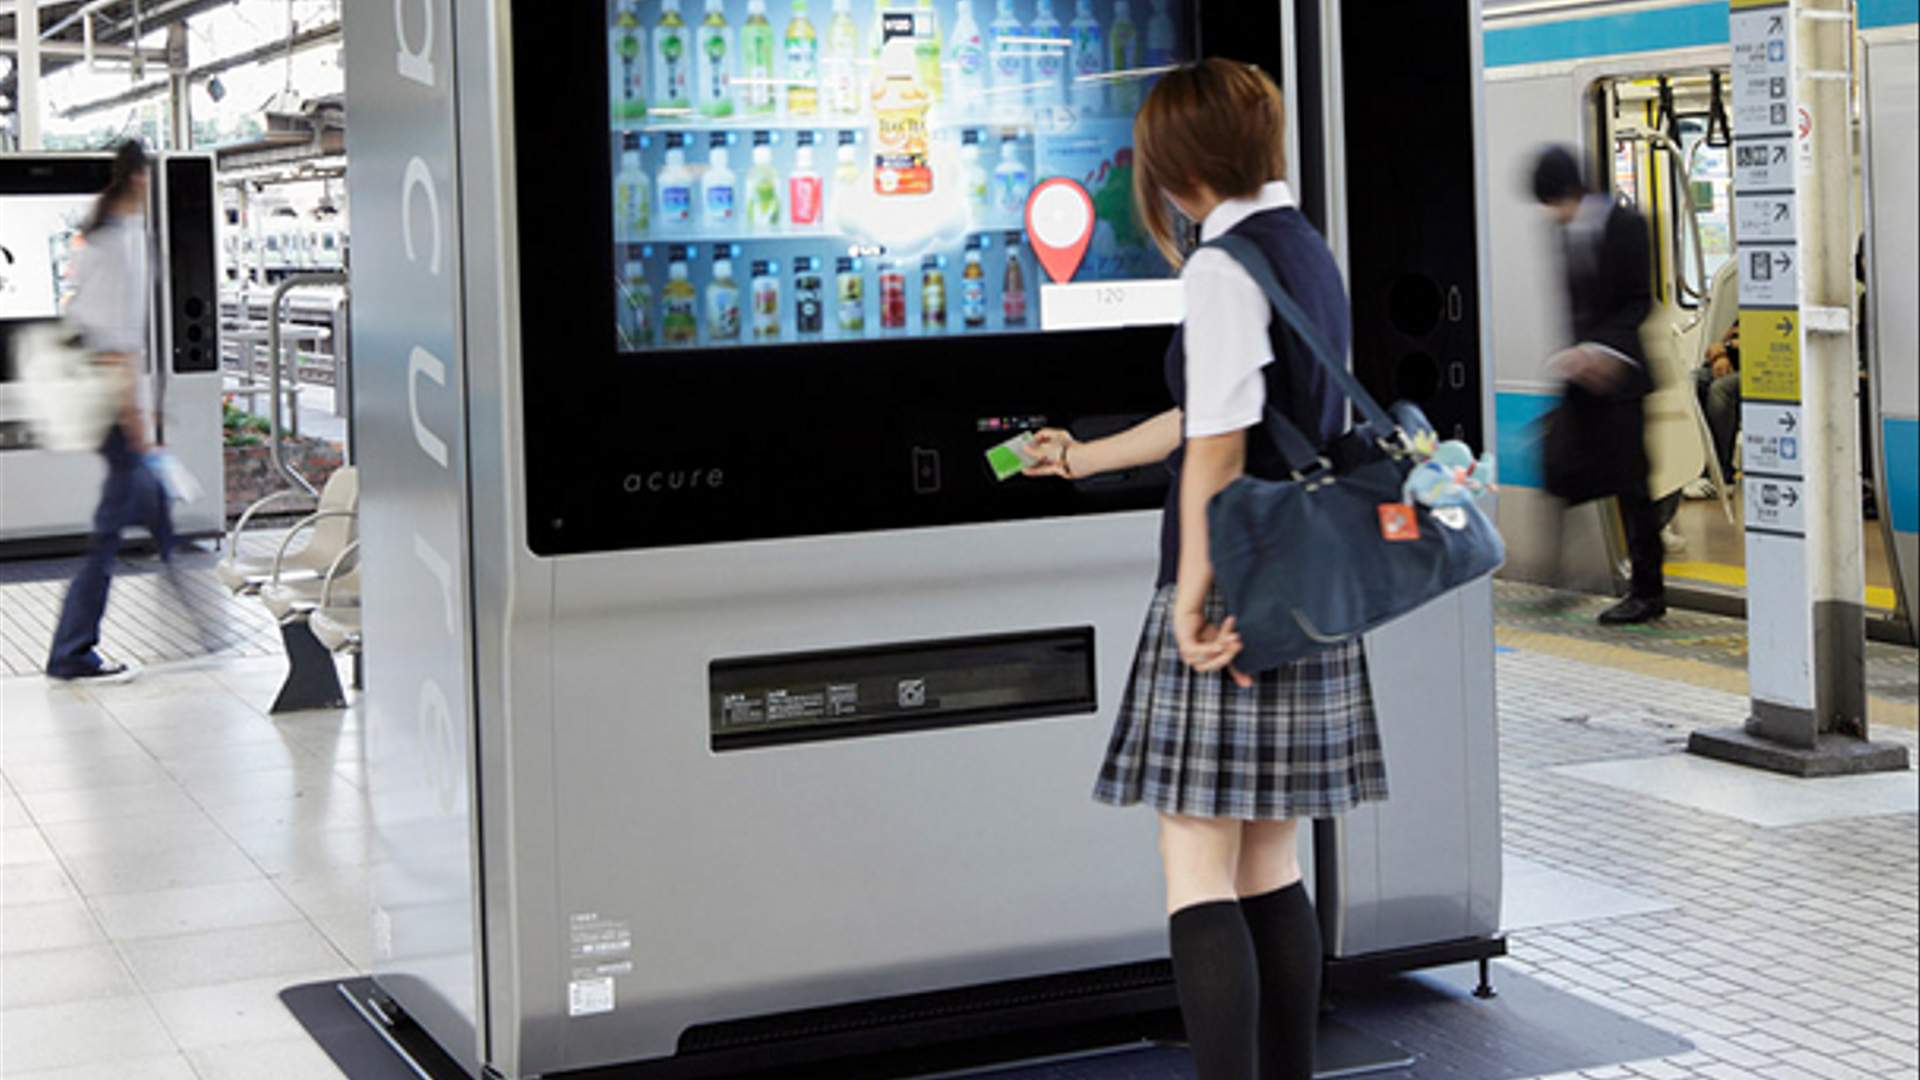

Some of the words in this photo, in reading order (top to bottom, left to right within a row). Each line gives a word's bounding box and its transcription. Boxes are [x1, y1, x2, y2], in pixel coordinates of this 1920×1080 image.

[1095, 287, 1127, 305] 120
[394, 0, 458, 816] acure
[622, 467, 724, 493] acure
